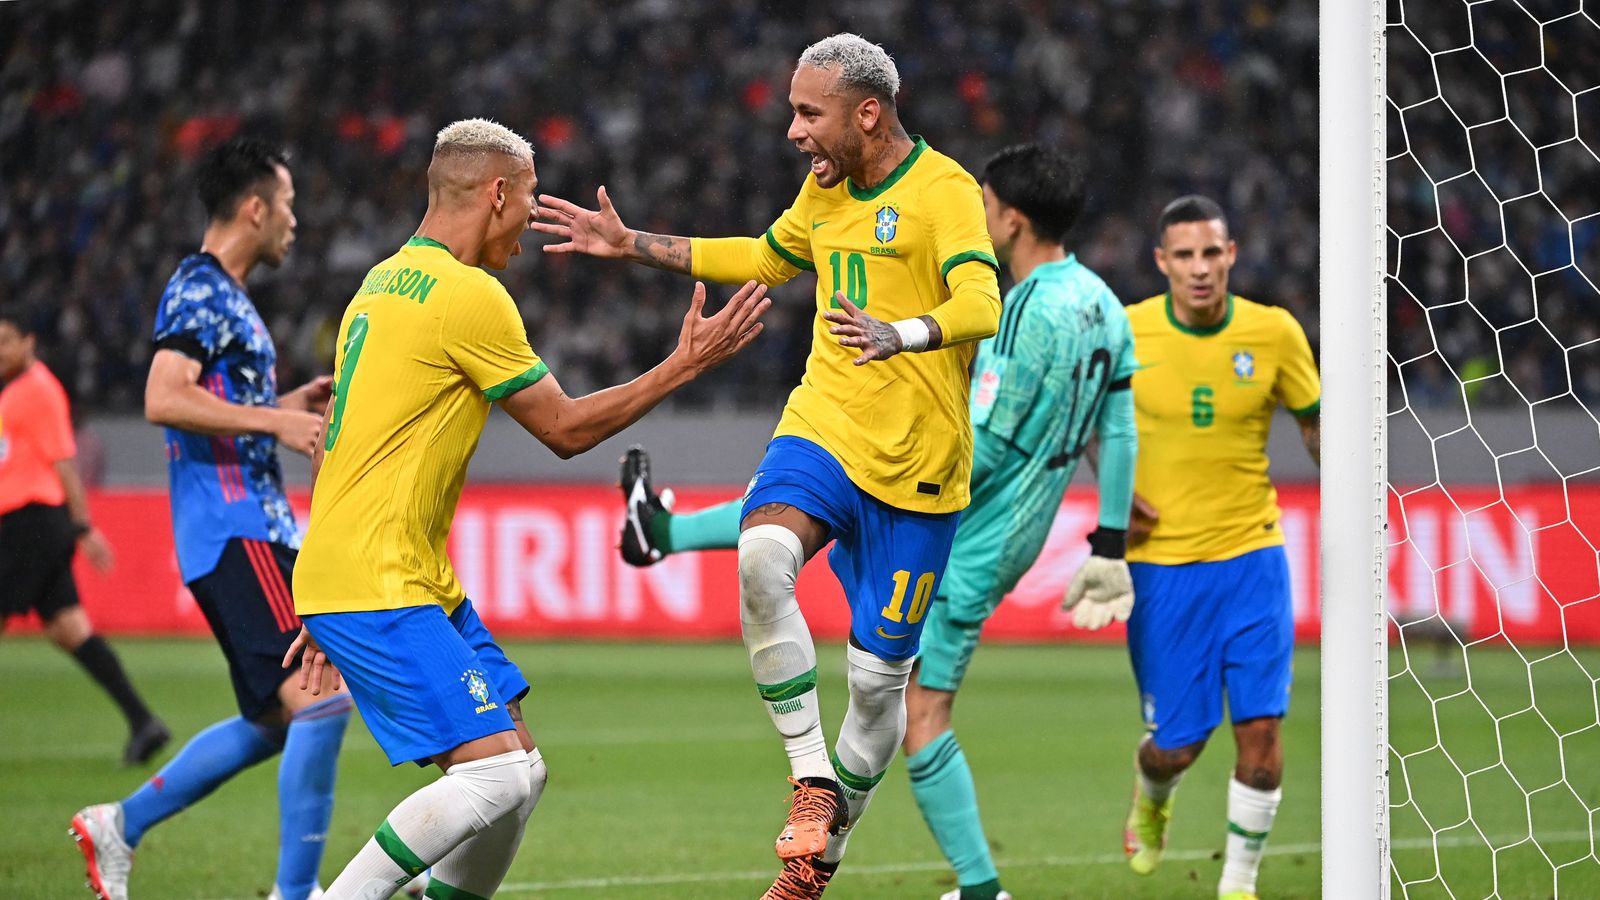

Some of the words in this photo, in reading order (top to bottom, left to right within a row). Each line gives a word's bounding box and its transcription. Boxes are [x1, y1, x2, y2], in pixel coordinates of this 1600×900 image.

[870, 246, 897, 255] BRASIL
[829, 251, 867, 311] 10
[1047, 347, 1112, 469] 12
[1191, 385, 1215, 428] 6
[456, 507, 703, 621] IRIN
[881, 569, 936, 625] 10
[475, 702, 498, 714] BRASIL
